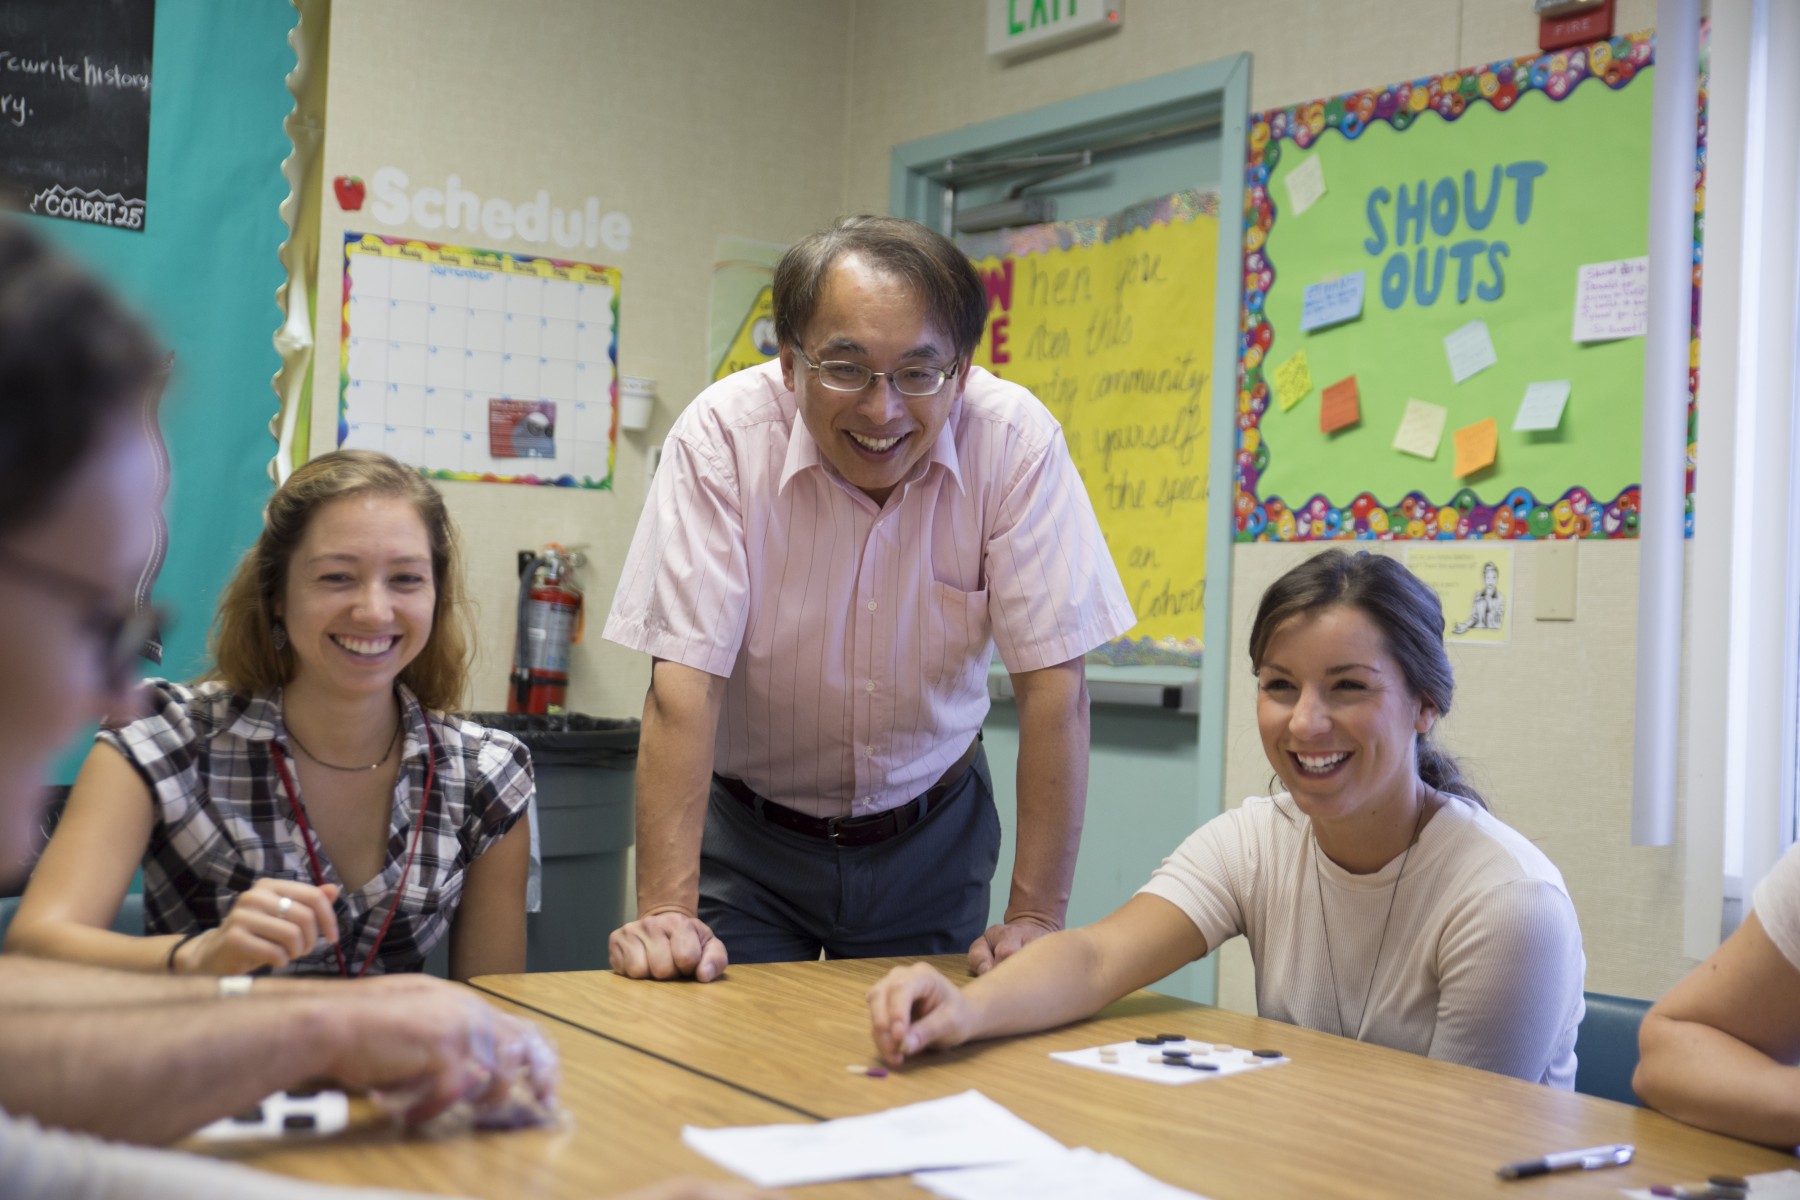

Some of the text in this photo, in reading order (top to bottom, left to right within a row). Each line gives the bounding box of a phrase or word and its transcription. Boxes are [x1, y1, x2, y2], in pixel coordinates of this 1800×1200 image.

[1553, 17, 1592, 37] FIRE
[45, 194, 145, 229] COHORT 25
[371, 165, 632, 251] Schedule
[1363, 160, 1549, 257] SHOUT
[1379, 239, 1511, 311] OUTS
[1088, 350, 1210, 412] community
[1104, 468, 1146, 511] the
